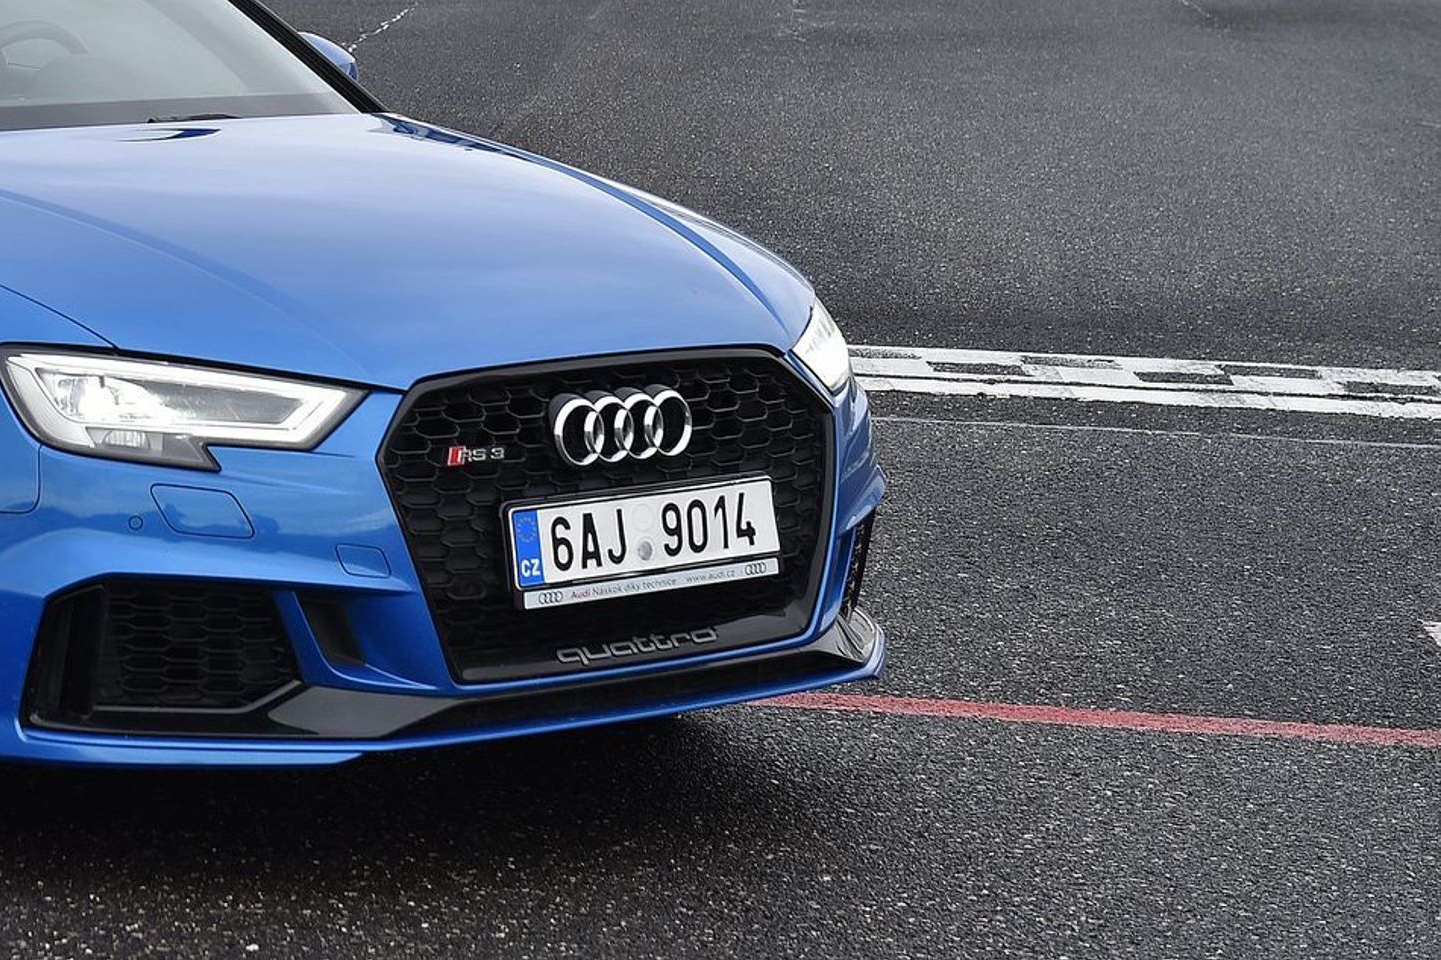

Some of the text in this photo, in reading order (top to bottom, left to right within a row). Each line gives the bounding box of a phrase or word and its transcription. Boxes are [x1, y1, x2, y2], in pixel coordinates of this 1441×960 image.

[455, 446, 505, 463] RS 3
[550, 491, 757, 571] 6AJ 9014
[521, 558, 541, 577] CZ
[570, 589, 591, 599] Audi
[642, 576, 677, 591] technice
[686, 569, 735, 584] www.audi.cz
[556, 627, 718, 666] quattro
